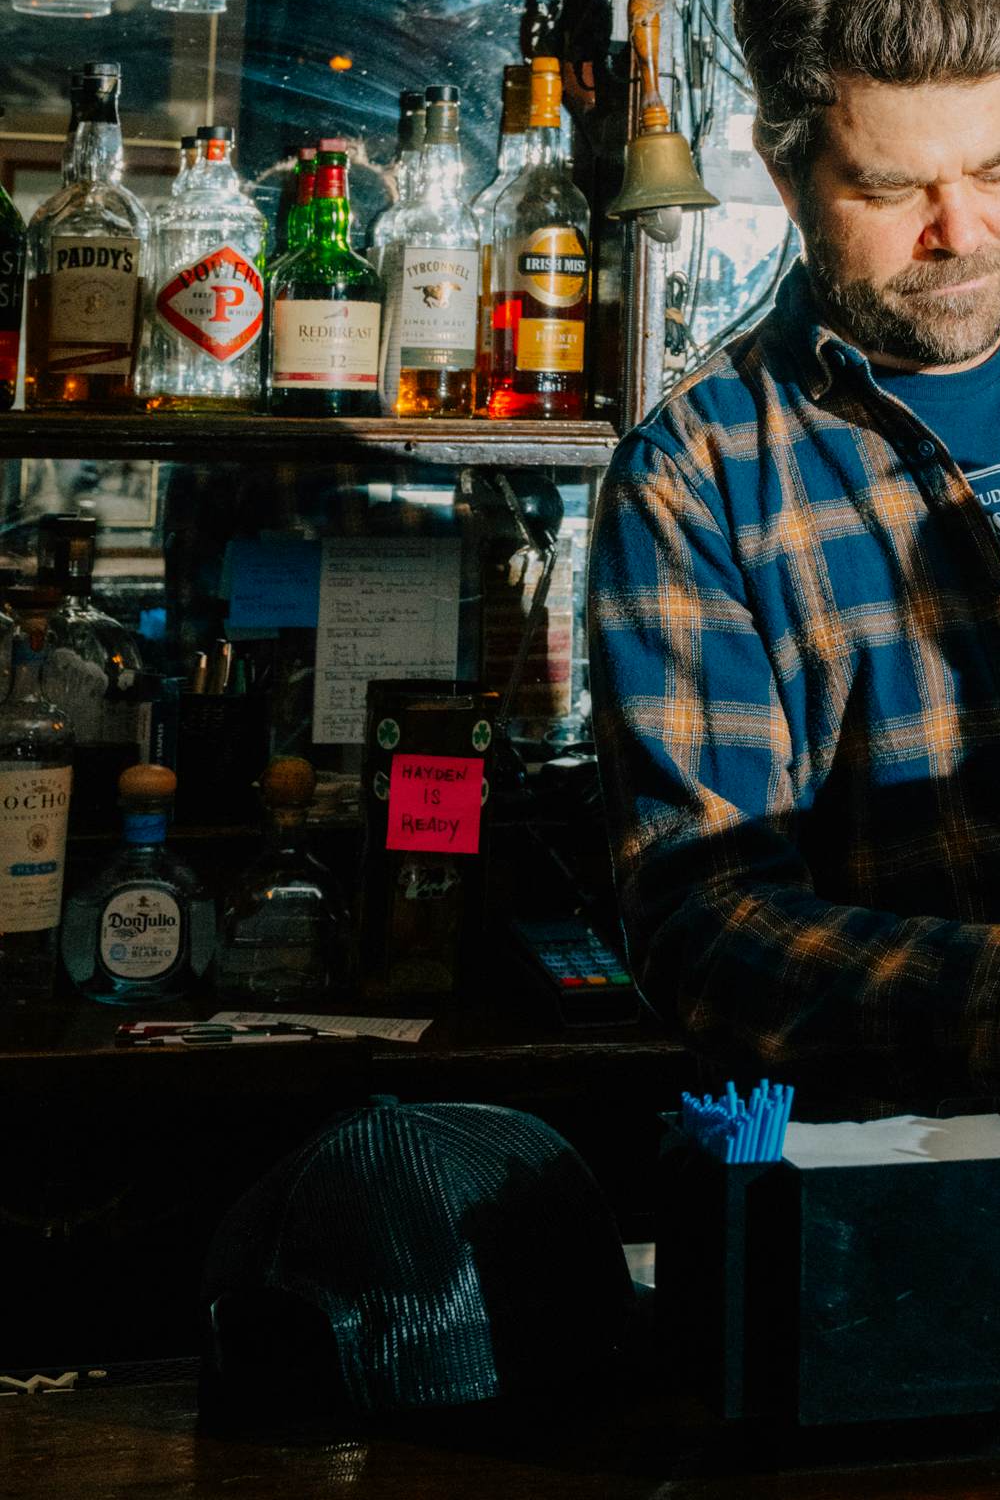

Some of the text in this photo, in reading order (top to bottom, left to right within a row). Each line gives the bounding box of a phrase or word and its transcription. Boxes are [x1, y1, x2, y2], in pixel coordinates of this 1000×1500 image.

[56, 246, 133, 273] PADDY'S
[525, 257, 587, 272] IRISH MIST
[406, 260, 470, 280] TYRCONNELL
[207, 285, 245, 322] P
[298, 324, 372, 339] REDBREAST
[329, 355, 347, 368] 12
[402, 764, 469, 782] HAYDEN
[3, 792, 67, 810] OCHO
[423, 786, 442, 806] IS
[401, 812, 461, 843] READY
[108, 912, 141, 929] Don
